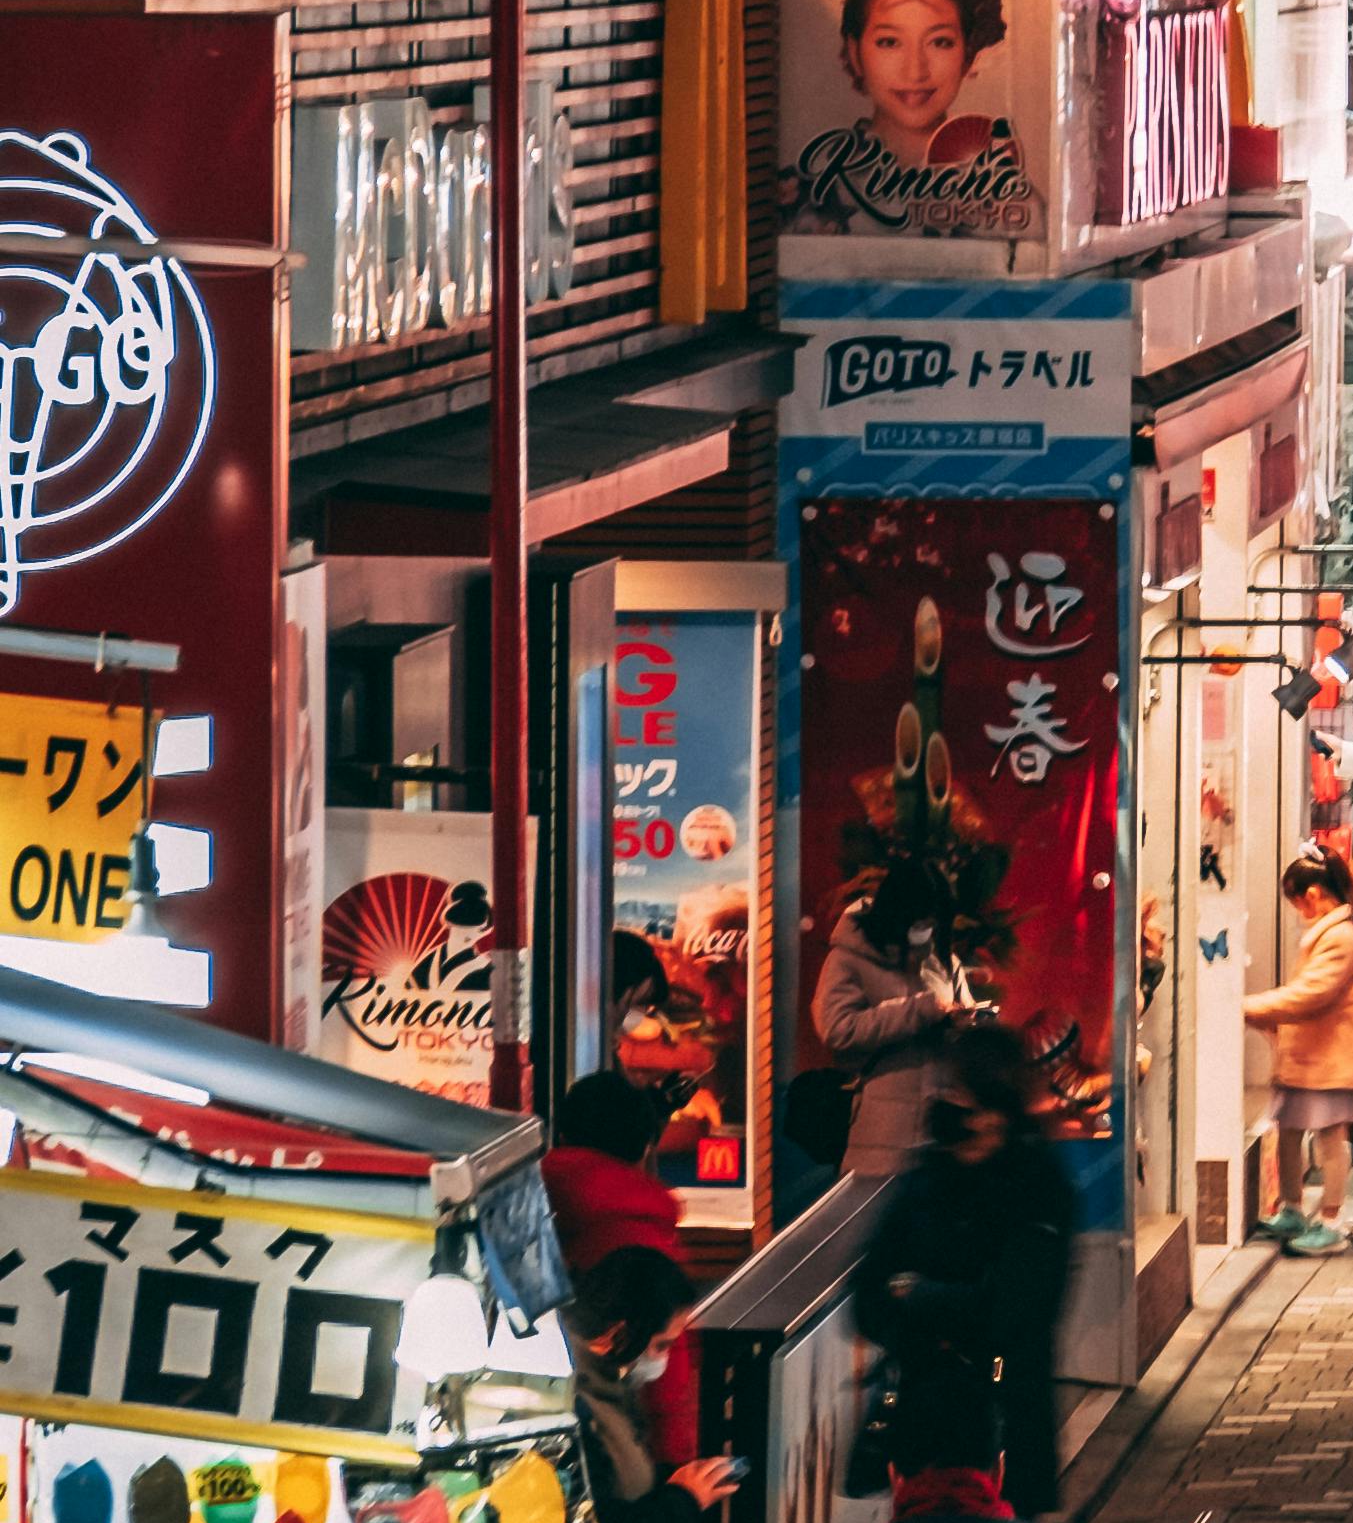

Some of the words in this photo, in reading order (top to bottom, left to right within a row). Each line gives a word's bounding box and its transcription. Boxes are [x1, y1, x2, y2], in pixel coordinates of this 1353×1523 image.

[798, 128, 1030, 228] Kimono
[909, 204, 1030, 229] TOKYO
[839, 344, 943, 394] GOTO
[968, 350, 1096, 389] トラベル
[984, 551, 1094, 784] 迎春
[9, 844, 132, 930] ONE
[321, 960, 496, 1052] Kimono
[80, 1202, 334, 1281] マスク
